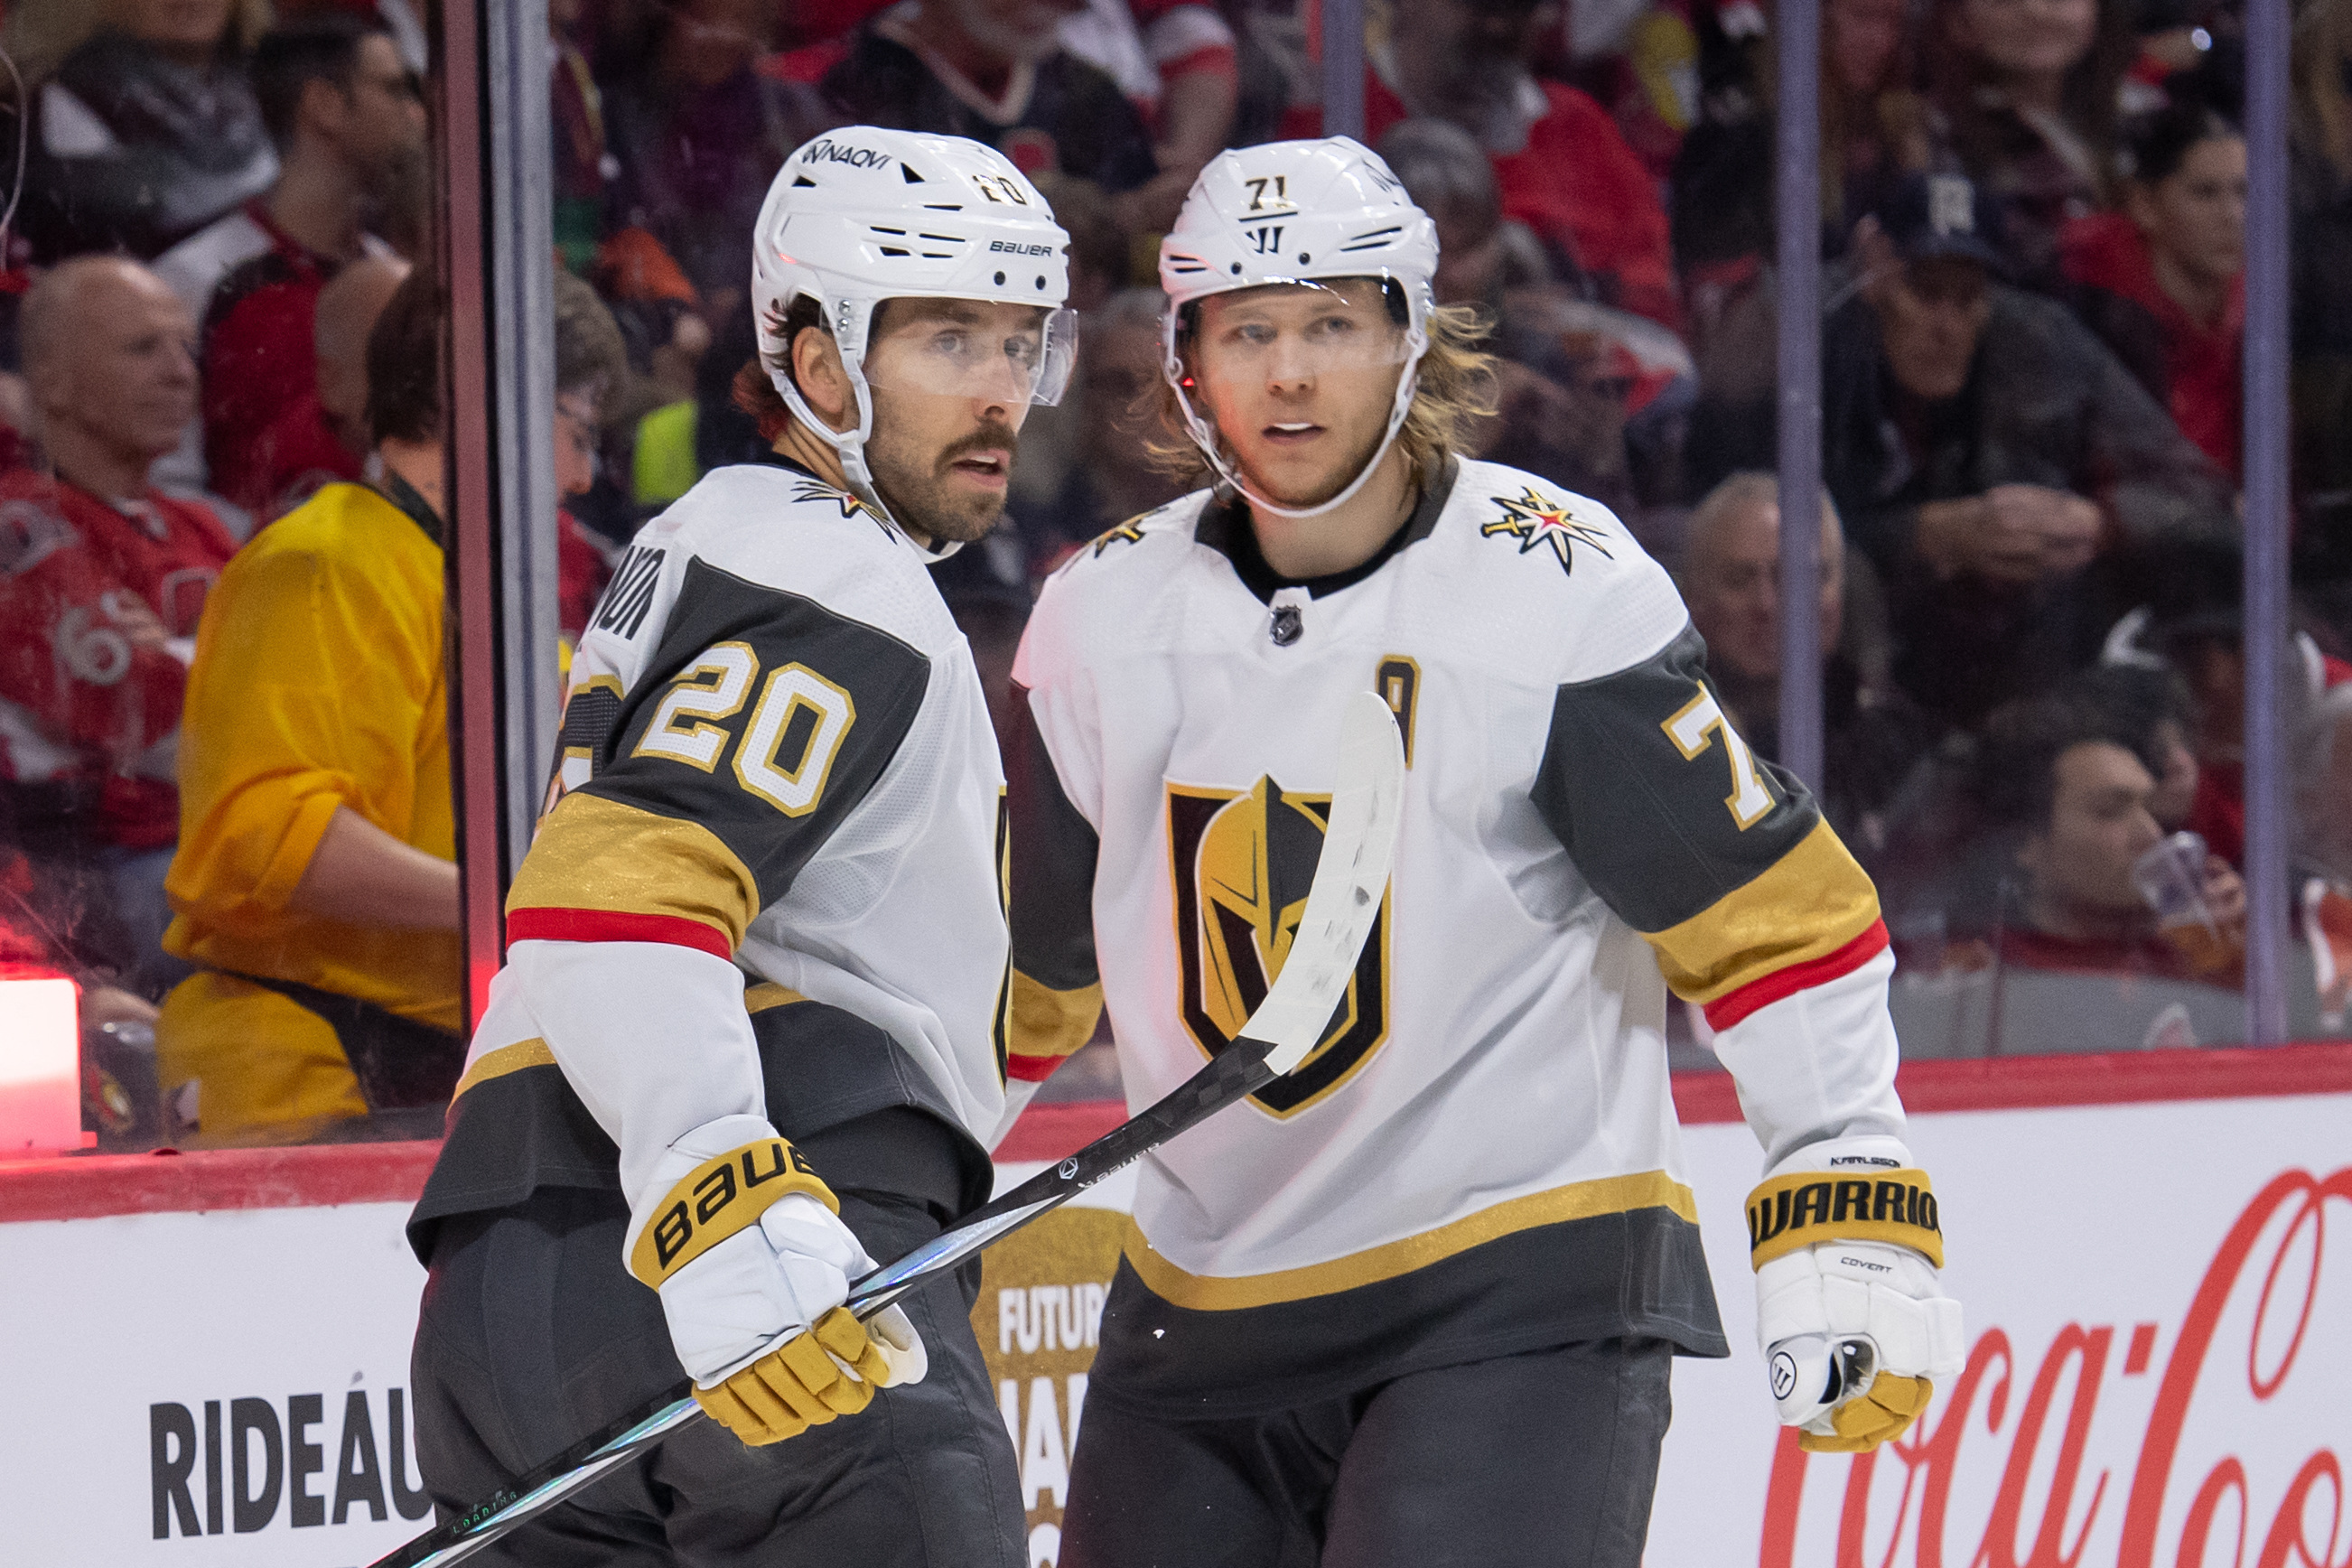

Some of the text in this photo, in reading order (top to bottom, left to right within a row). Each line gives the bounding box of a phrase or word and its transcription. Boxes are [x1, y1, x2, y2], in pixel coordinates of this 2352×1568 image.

[1245, 175, 1292, 210] 71
[989, 240, 1053, 257] BAUER
[630, 640, 857, 818] 20
[1660, 679, 1786, 832] 7
[654, 1143, 817, 1271] BAUE
[1750, 1180, 1943, 1252] WARRIO
[1840, 1255, 1894, 1274] COVERT
[998, 1282, 1112, 1354] FUTUR
